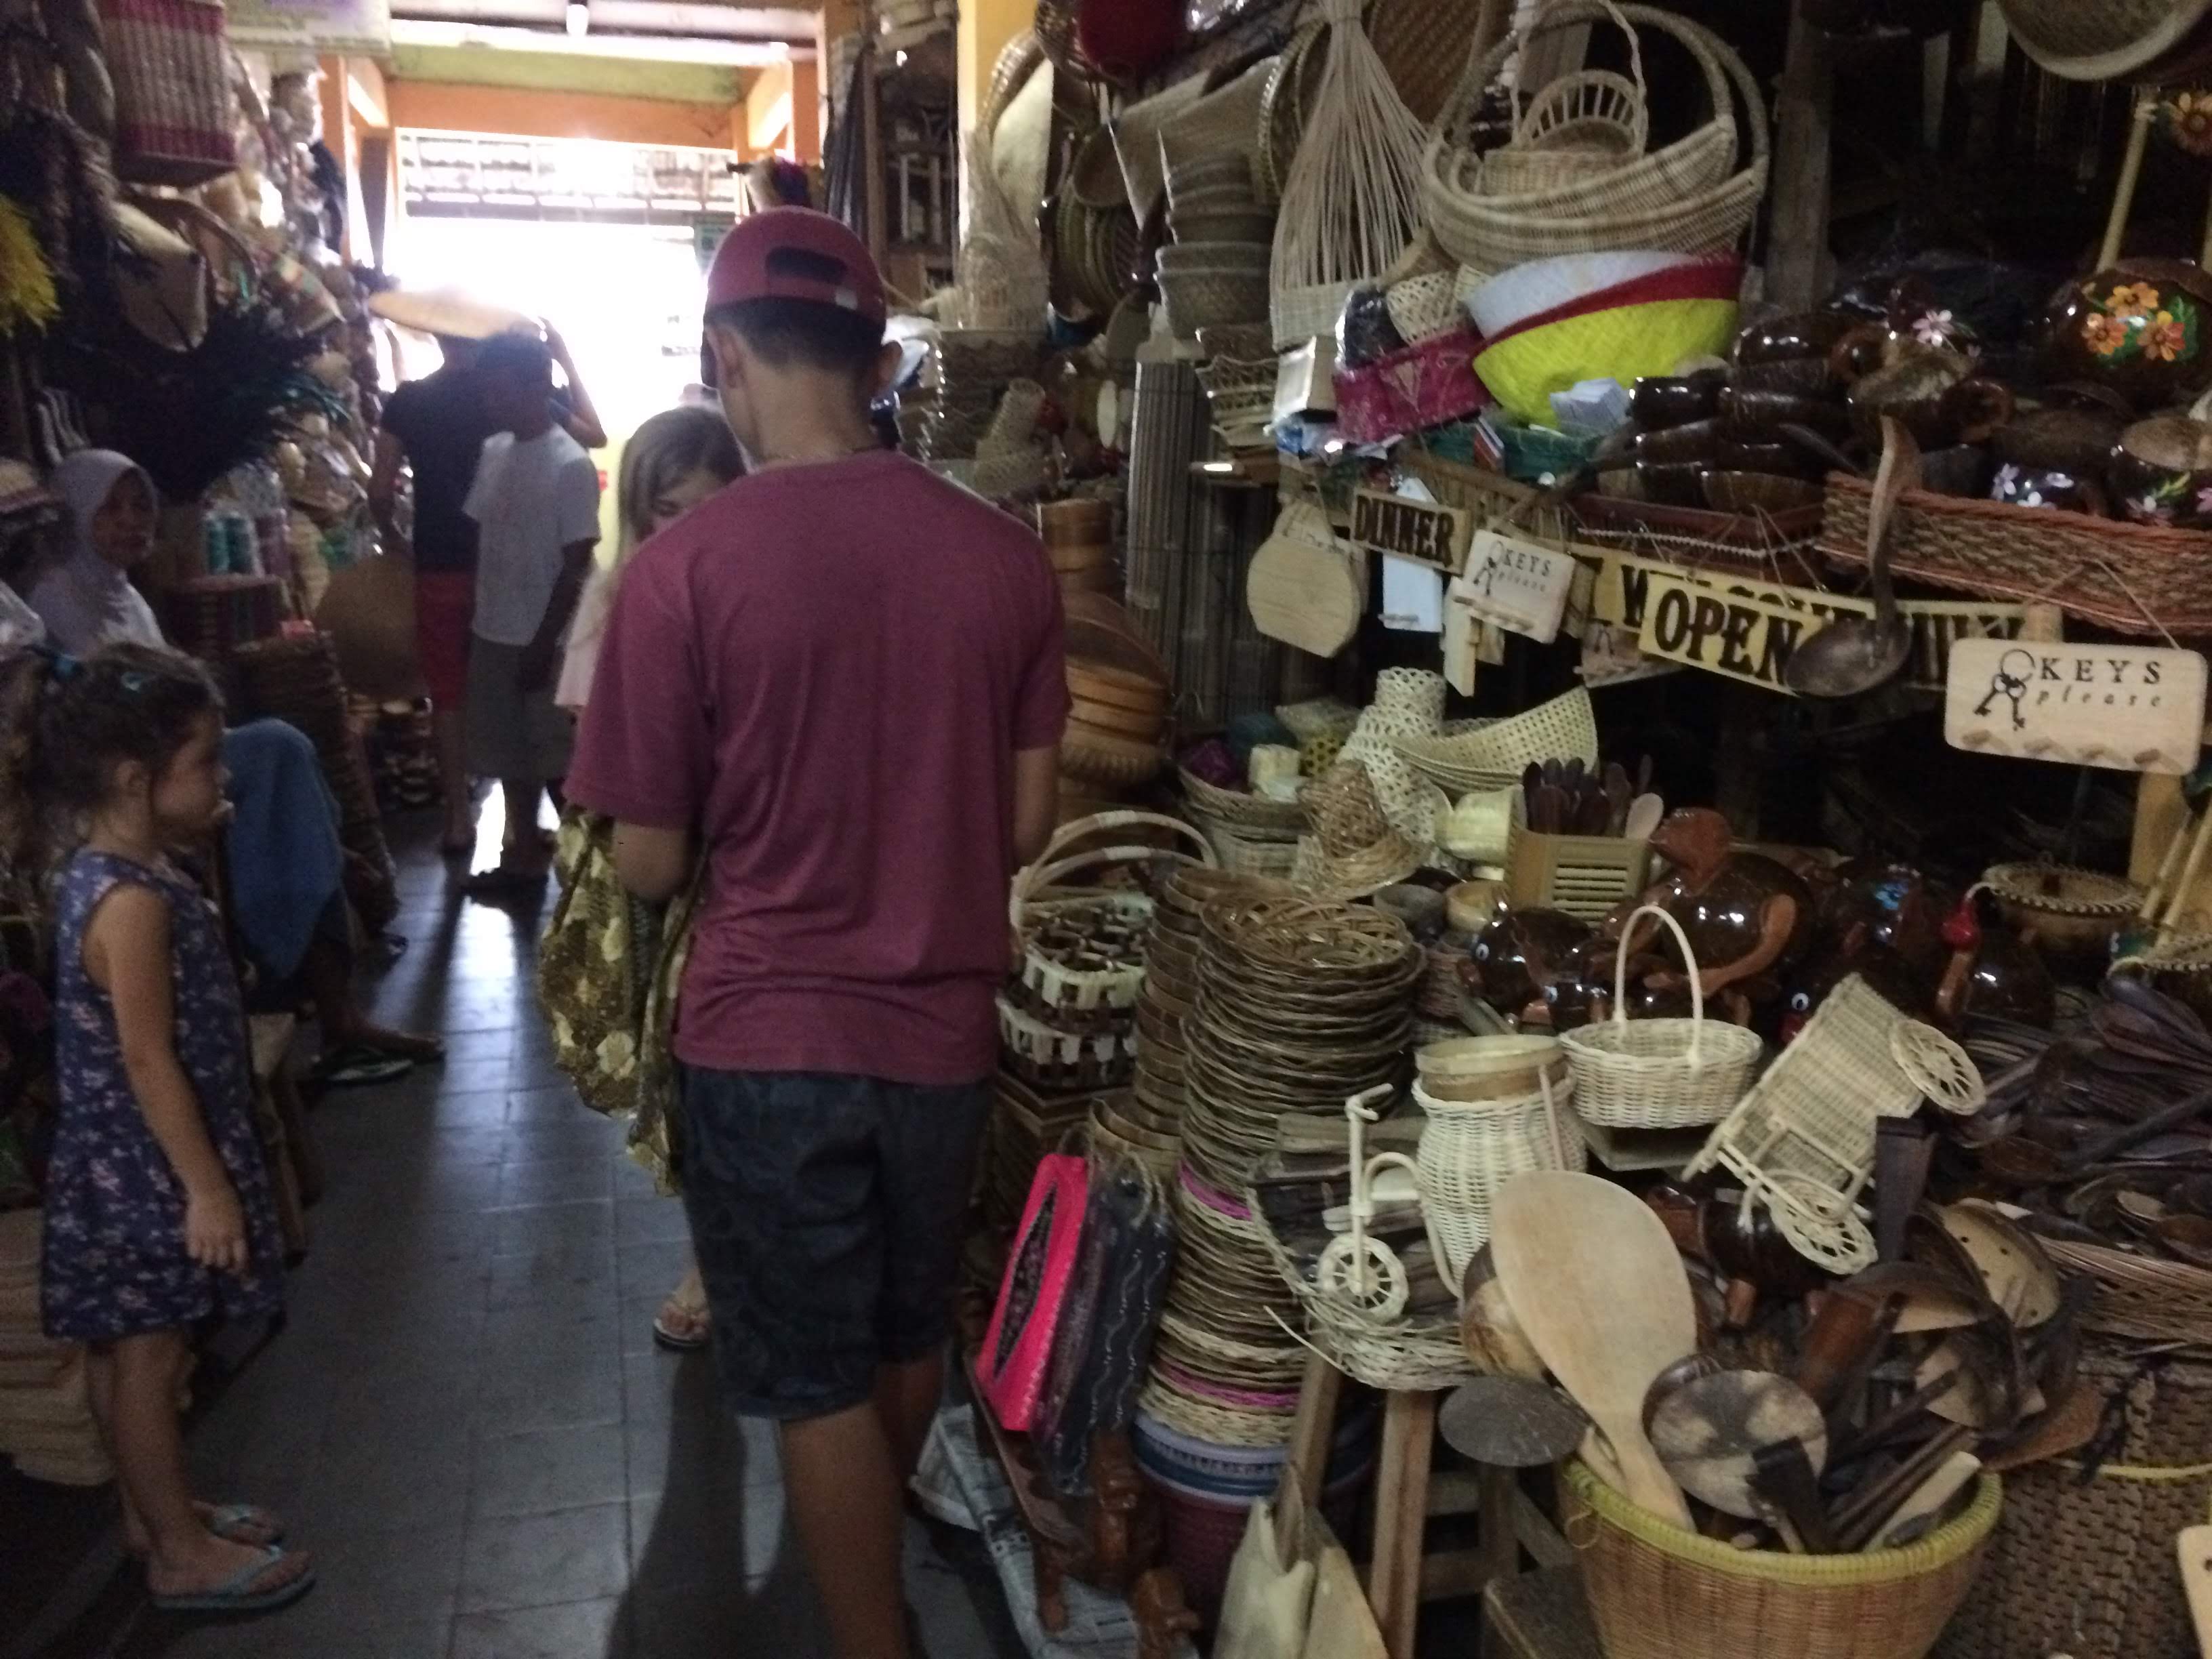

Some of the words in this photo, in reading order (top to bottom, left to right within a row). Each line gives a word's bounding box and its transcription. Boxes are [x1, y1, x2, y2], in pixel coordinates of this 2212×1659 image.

[1355, 495, 1454, 567] DINNER
[1504, 549, 1551, 576] KEYS
[1655, 588, 1804, 686] OPEN
[2041, 657, 2160, 684] KEYS
[2036, 684, 2160, 707] please
